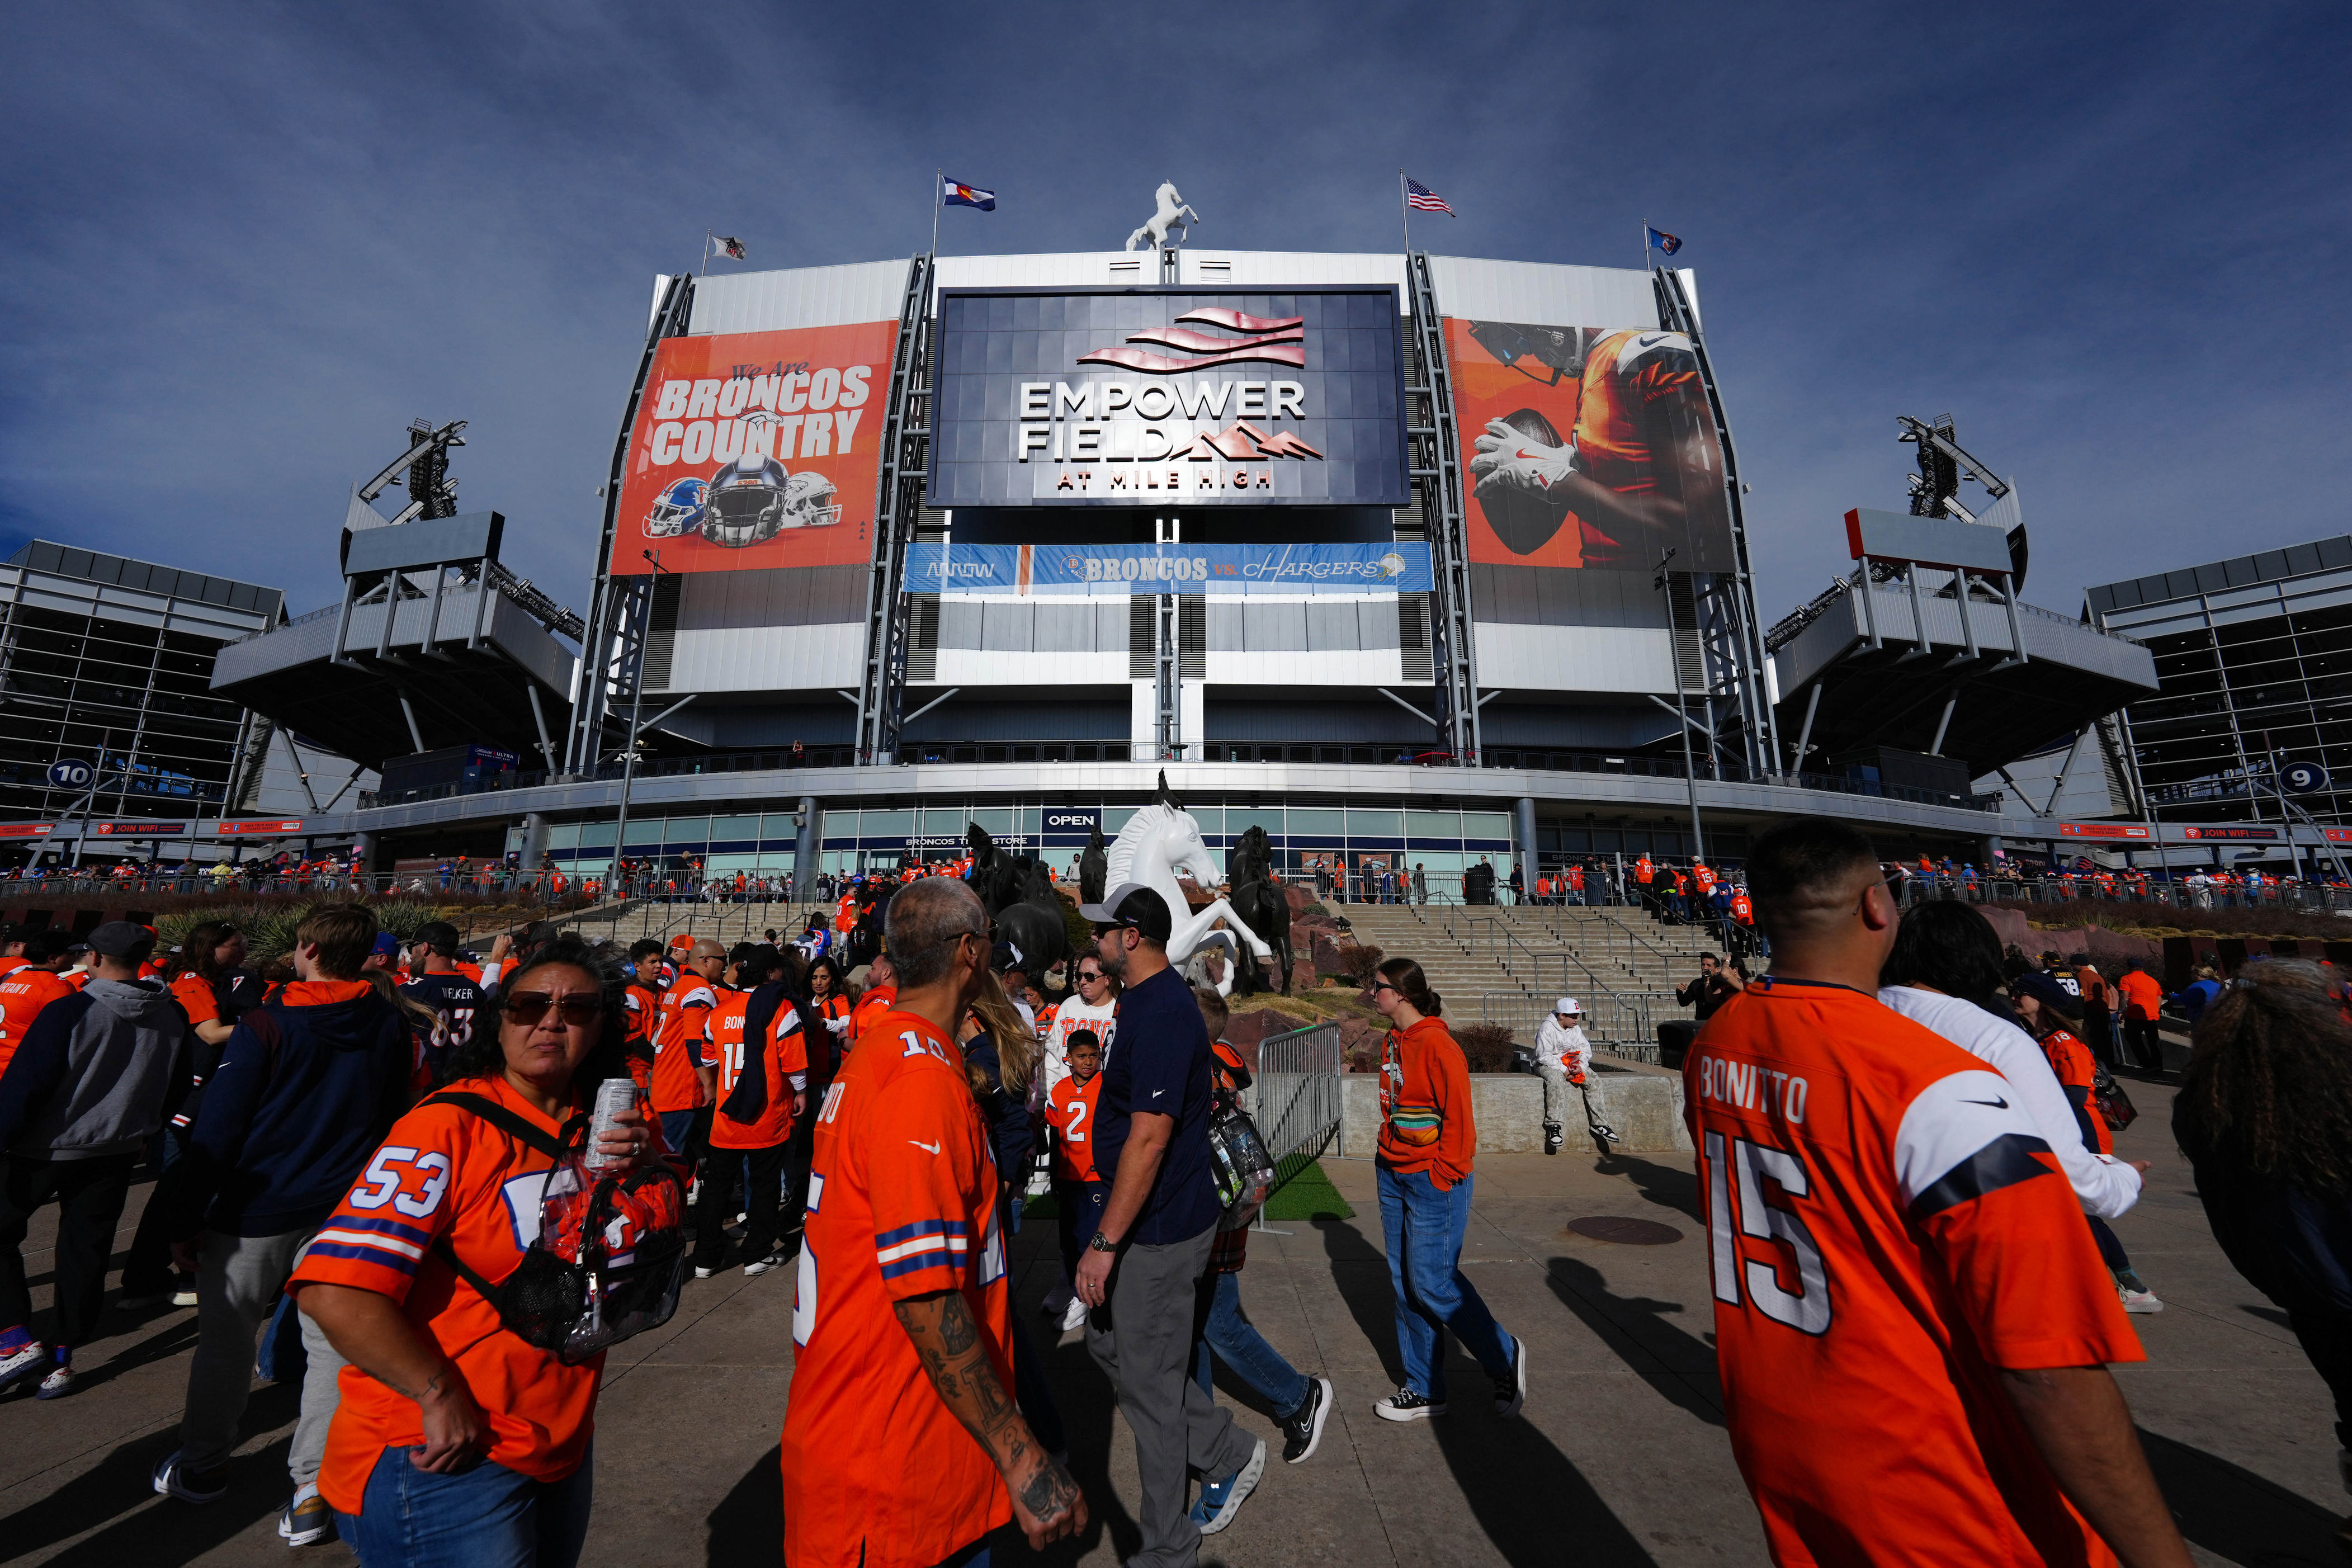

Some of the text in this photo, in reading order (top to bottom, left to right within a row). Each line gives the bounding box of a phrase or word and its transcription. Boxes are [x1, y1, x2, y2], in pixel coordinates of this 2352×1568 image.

[732, 360, 809, 382] We Are
[655, 365, 872, 419] BRONCOS
[1020, 380, 1306, 420] EMPOWER
[650, 408, 863, 465] COUNTRY
[1018, 422, 1174, 463] FIELD
[1057, 470, 1271, 490] AT MILE HIGH
[1087, 558, 1208, 581] BRONCOS
[1243, 545, 1380, 586] CHARGERS
[56, 766, 88, 783] 10
[2290, 769, 2311, 787] 9
[115, 824, 137, 833] JOIN
[1049, 816, 1094, 826] OPEN
[2204, 829, 2226, 837] JOIN
[1644, 865, 1651, 873] 10
[1702, 873, 1712, 883] 15
[1737, 904, 1748, 914] 10
[442, 987, 474, 999] WELKER
[2056, 978, 2080, 996] 58
[430, 1008, 475, 1047] 83
[2053, 1032, 2071, 1043] 18
[724, 1043, 745, 1091] 15
[1700, 1055, 1808, 1125] BONITTO
[1066, 1101, 1087, 1142] 2
[348, 1145, 451, 1220] 53
[1704, 1128, 1834, 1337] 15
